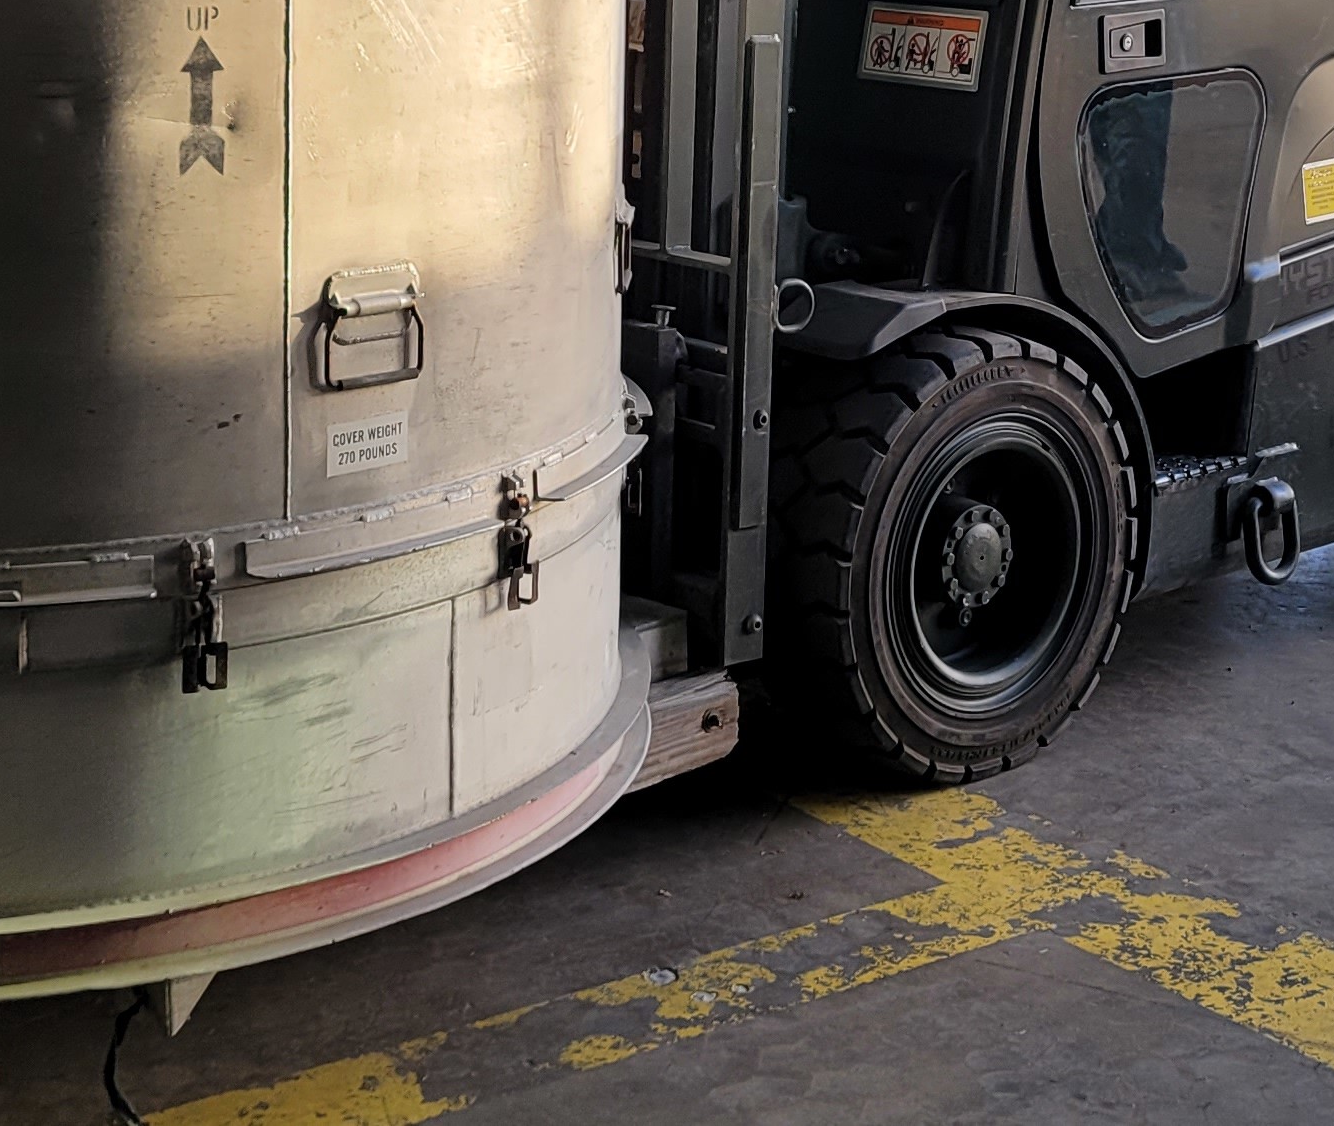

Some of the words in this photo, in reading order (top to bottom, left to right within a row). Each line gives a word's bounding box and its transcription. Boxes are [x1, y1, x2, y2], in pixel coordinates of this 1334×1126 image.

[187, 5, 219, 32] UP
[332, 429, 365, 447] COVER
[367, 421, 403, 441] WEIGHT
[338, 450, 356, 466] 270
[358, 442, 398, 462] POUNDS
